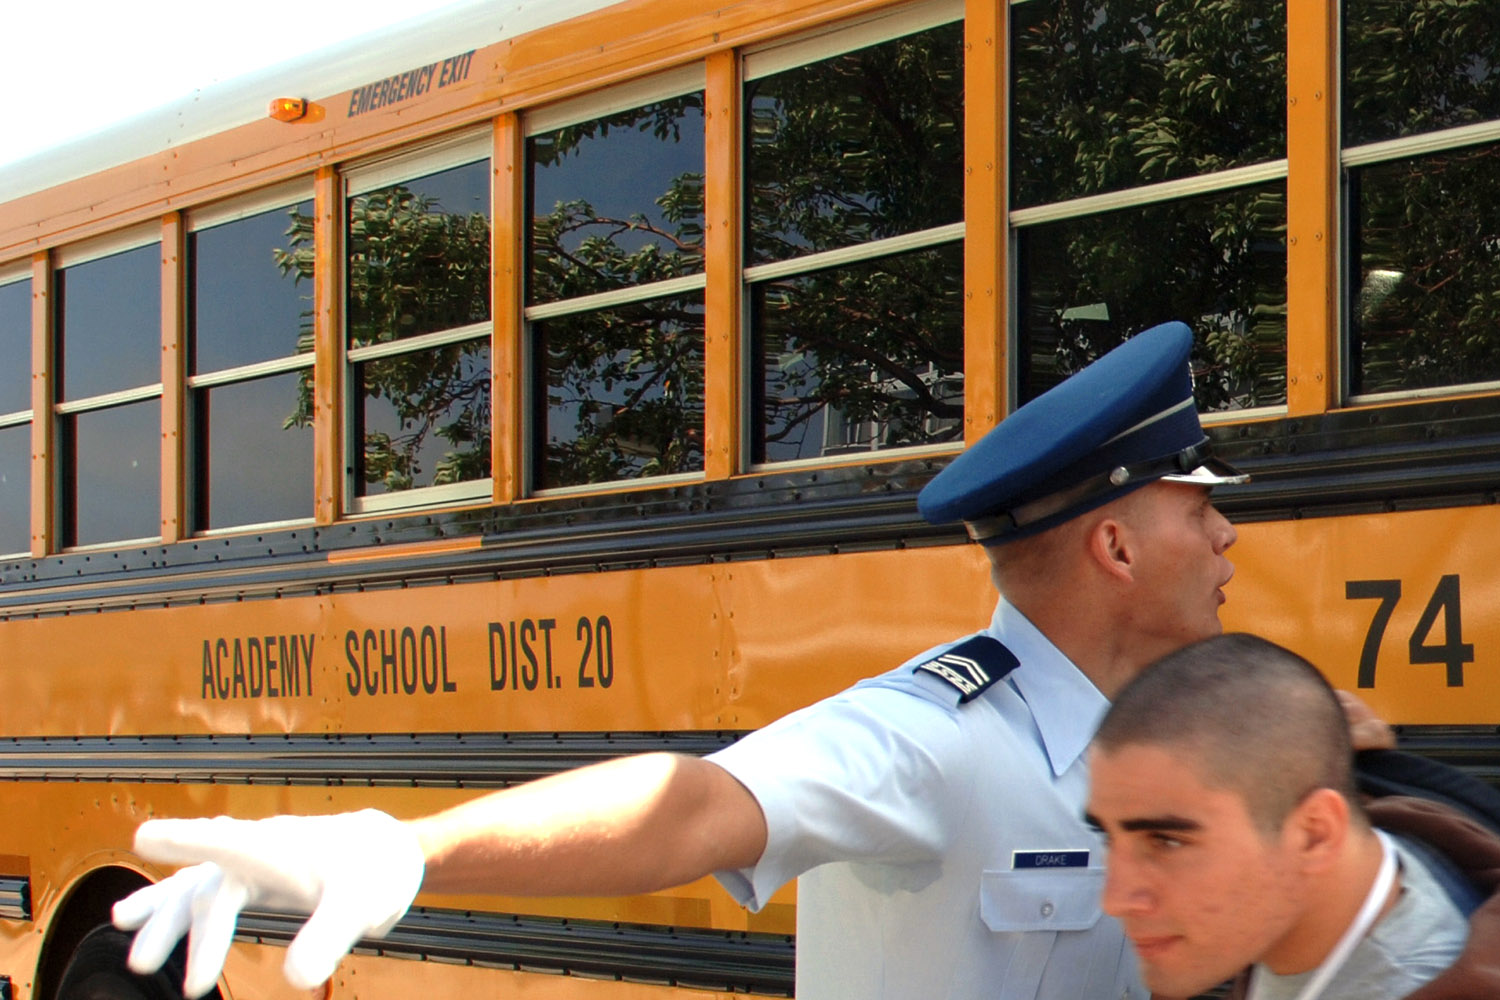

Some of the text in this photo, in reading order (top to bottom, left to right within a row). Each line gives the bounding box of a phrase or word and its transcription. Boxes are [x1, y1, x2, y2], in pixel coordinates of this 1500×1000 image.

[347, 48, 477, 118] EMERGENCY EXIT
[202, 615, 613, 700] ACADEMY SCHOOL DIST. 20
[1345, 573, 1474, 689] 74
[1034, 854, 1068, 866] DRAKE
